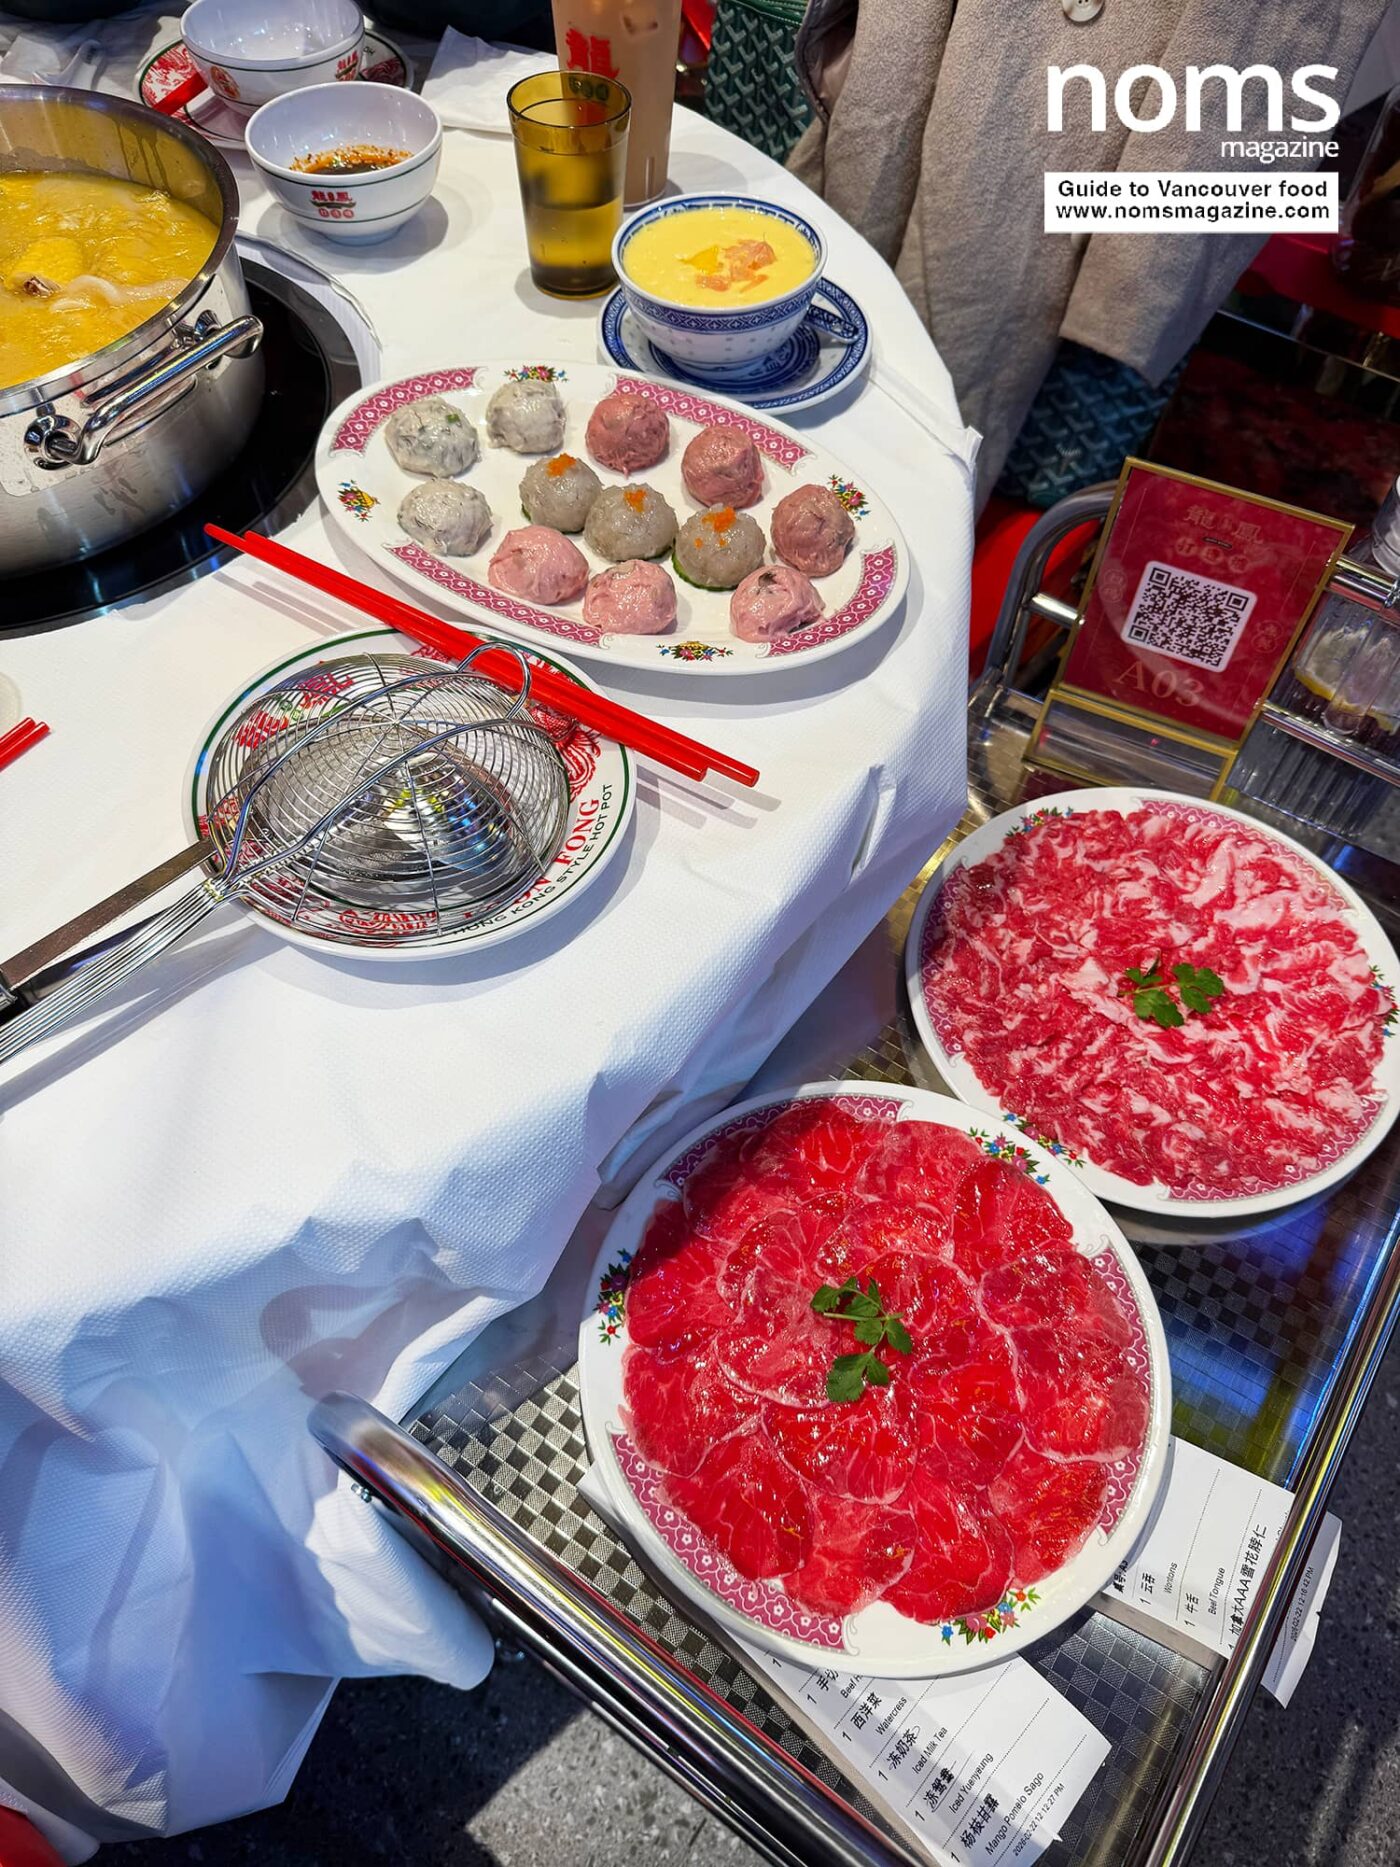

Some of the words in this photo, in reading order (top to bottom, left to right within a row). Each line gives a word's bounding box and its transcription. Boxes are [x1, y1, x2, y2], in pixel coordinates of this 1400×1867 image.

[1115, 660, 1204, 707] A03
[555, 799, 600, 866] FONG
[510, 886, 556, 914] KONG
[557, 844, 595, 883] STYLE
[590, 814, 608, 841] HOT
[601, 784, 613, 810] POT
[1141, 1572, 1155, 1594] 云吞
[1164, 1562, 1178, 1594] Wontons
[1305, 1566, 1314, 1579] PM
[1209, 1567, 1226, 1602] Tongue
[1140, 1597, 1151, 1605] 1
[1185, 1592, 1199, 1614] 牛舌
[1185, 1619, 1195, 1627] 1
[772, 1658, 782, 1668] 1
[807, 1693, 817, 1704] 1
[840, 1678, 858, 1699] Beef
[842, 1730, 852, 1742] 1
[850, 1692, 882, 1730] 西洋菜
[874, 1696, 908, 1736] Watercress
[878, 1770, 888, 1781] 1
[886, 1729, 917, 1770] 冻奶茶
[912, 1757, 927, 1774] Iced
[925, 1741, 938, 1759] Milk
[935, 1726, 948, 1743] Tea
[1054, 1782, 1066, 1796] PM
[915, 1810, 926, 1822] 1
[949, 1796, 965, 1814] Iced
[985, 1824, 1008, 1856] Mango
[1004, 1794, 1027, 1826] Pomelo
[1023, 1772, 1044, 1797] Sago
[951, 1852, 960, 1863] 1
